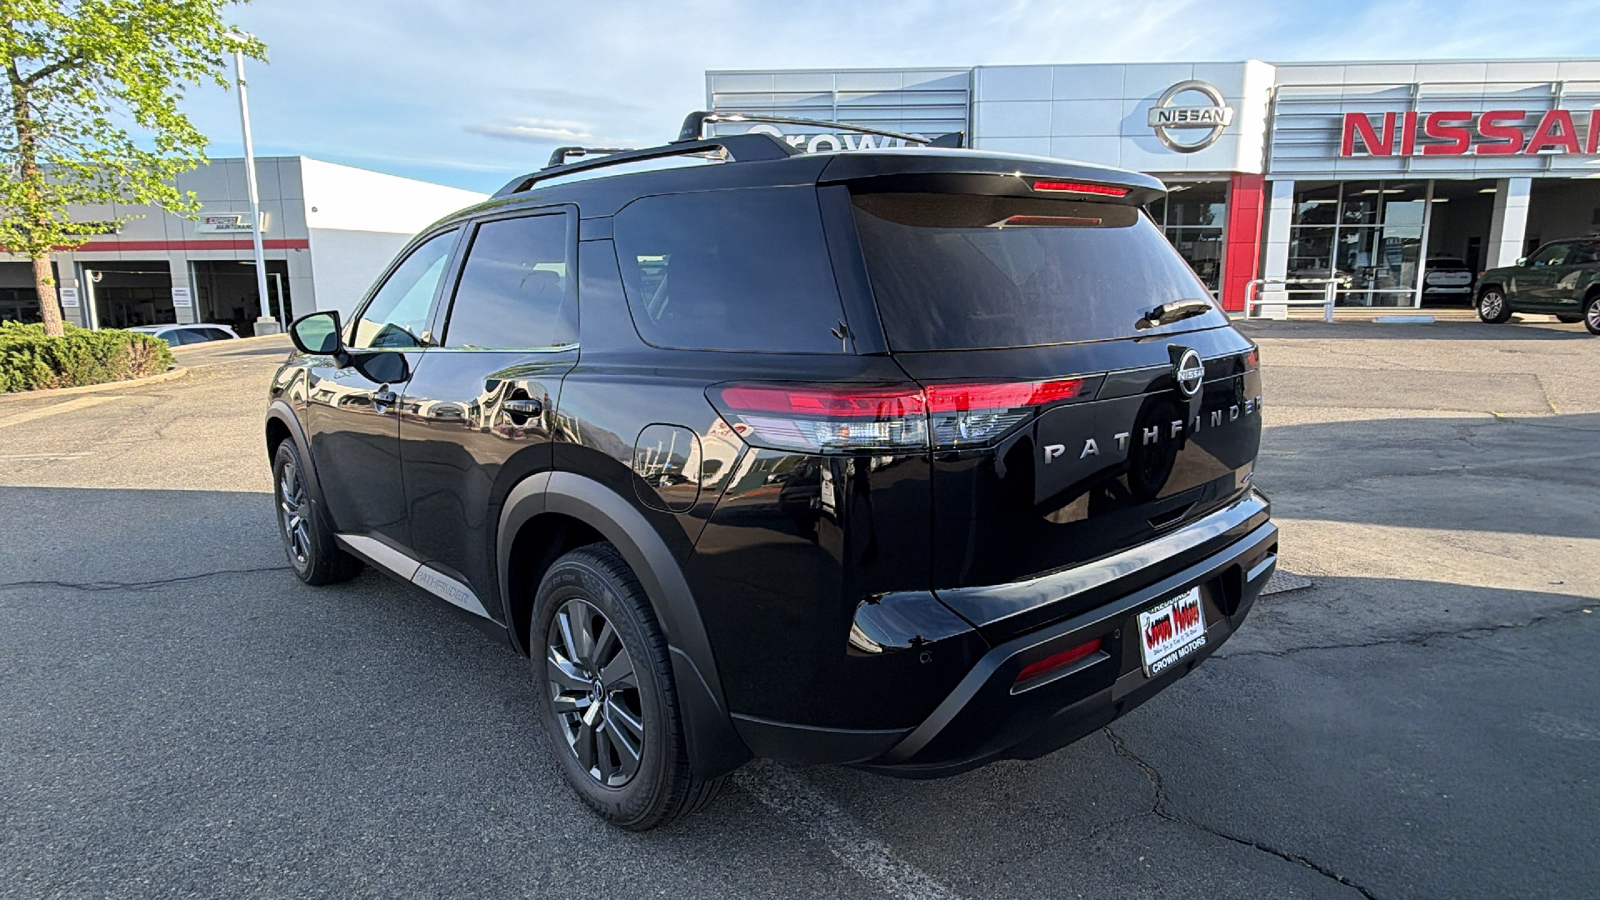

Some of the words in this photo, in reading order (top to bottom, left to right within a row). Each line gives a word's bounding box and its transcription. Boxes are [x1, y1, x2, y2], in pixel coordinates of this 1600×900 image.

[1158, 109, 1225, 122] NISSAN
[1341, 109, 1600, 156] NISSA
[416, 570, 470, 604] PATHFINDER
[1152, 651, 1179, 673] CROWN
[1178, 636, 1206, 658] MOTORS
